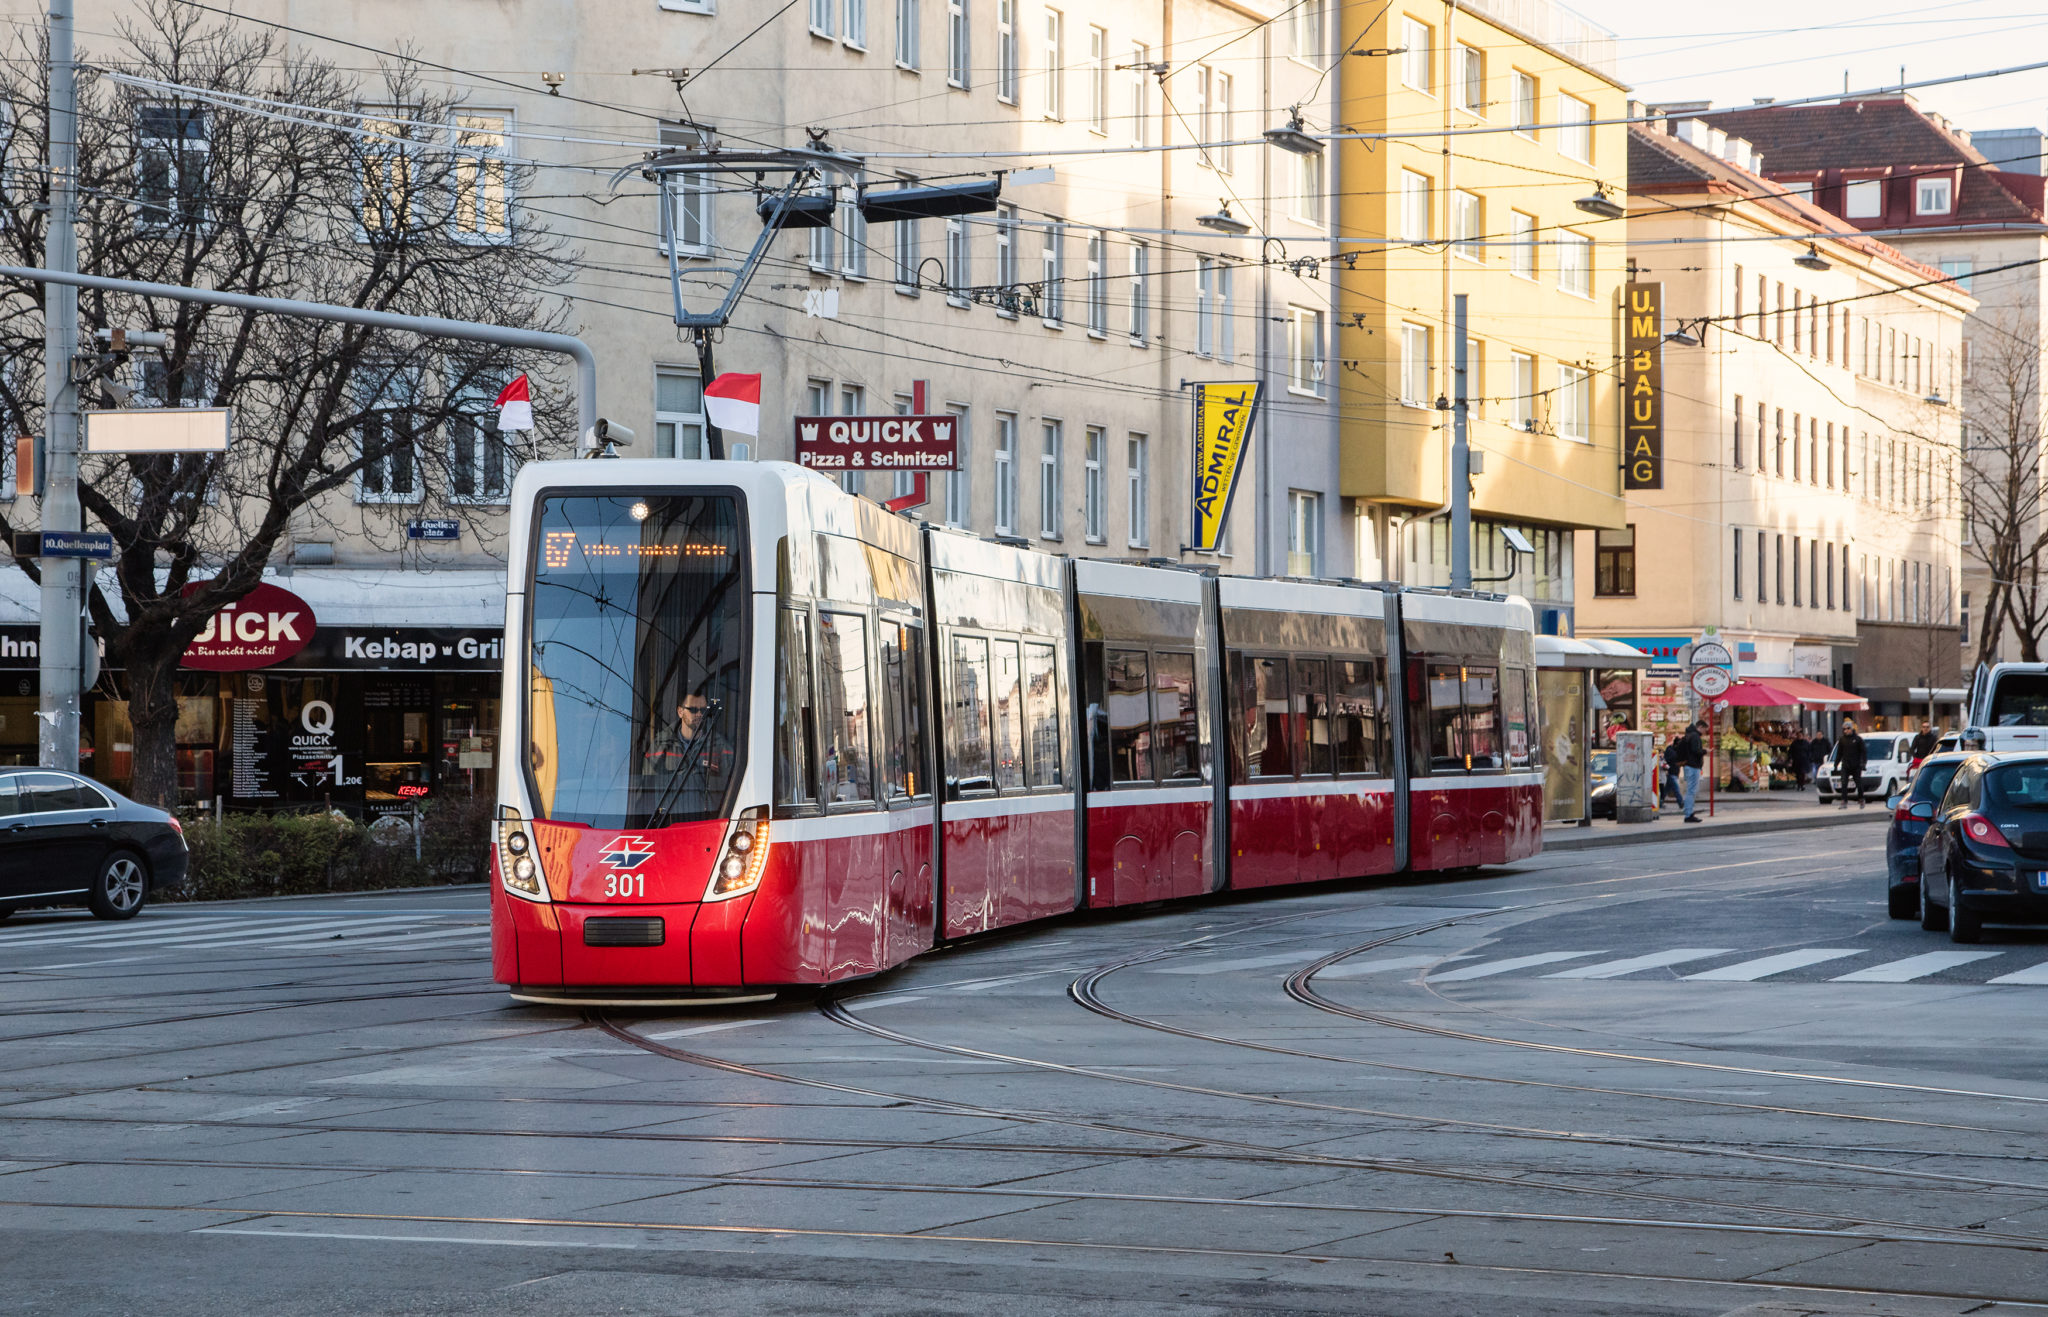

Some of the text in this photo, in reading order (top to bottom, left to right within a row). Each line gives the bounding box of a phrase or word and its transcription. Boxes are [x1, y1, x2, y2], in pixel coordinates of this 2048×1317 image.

[828, 420, 924, 445] QUICK
[800, 451, 953, 467] Pizza & Schnitzel
[1195, 390, 1247, 519] ADMIRAL
[545, 532, 577, 567] 67
[171, 611, 301, 642] UICK
[246, 645, 276, 656] nicht!
[345, 637, 437, 664] Kebap
[302, 700, 335, 736] Q
[292, 735, 330, 746] QUICK
[604, 873, 645, 898] 301
